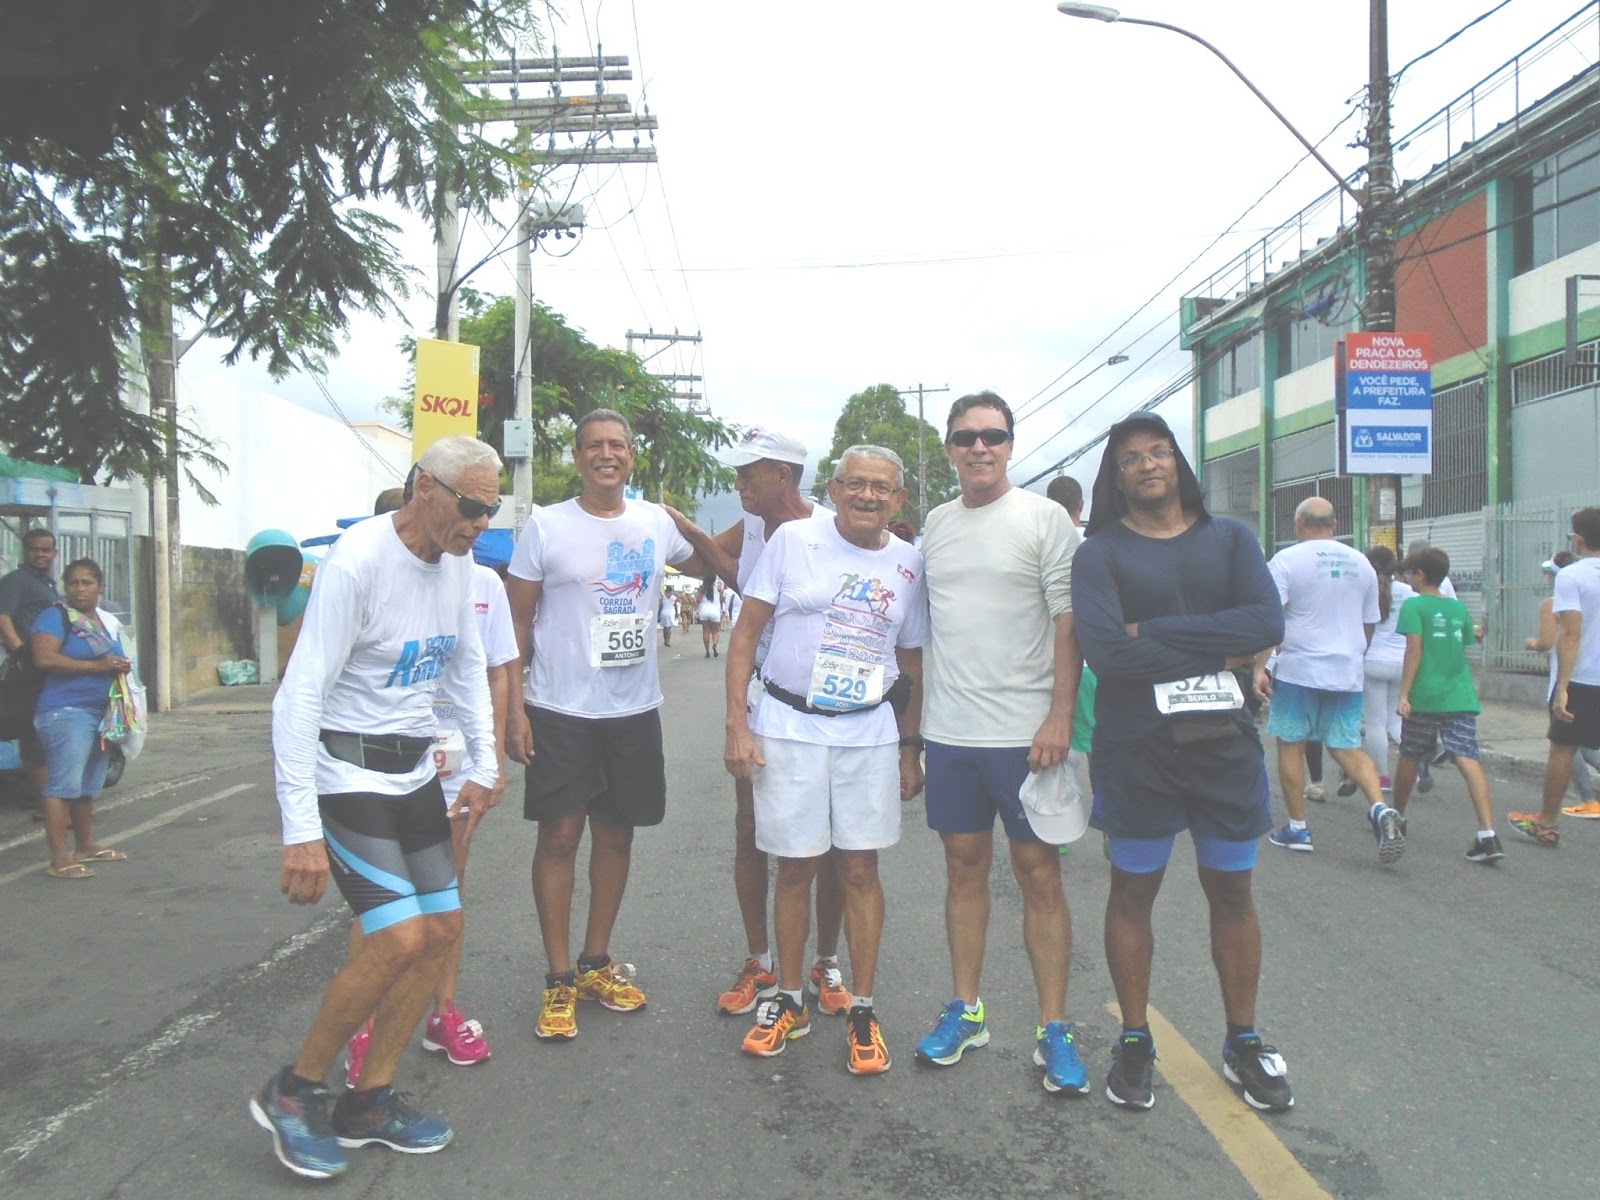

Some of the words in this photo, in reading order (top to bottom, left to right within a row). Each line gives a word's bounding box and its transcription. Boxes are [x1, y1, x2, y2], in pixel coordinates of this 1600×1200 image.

[1372, 336, 1405, 347] NOVA
[1356, 348, 1395, 359] PRAÇA
[1397, 348, 1422, 358] DOS
[1350, 360, 1428, 370] DENDEZEIROS
[1360, 374, 1388, 386] VOCÊ
[1389, 376, 1420, 387] PEDE,
[1353, 386, 1361, 395] A
[1363, 386, 1426, 396] PREFEITURA
[420, 393, 473, 418] SKOL
[1378, 396, 1401, 406] FAZ.
[1376, 432, 1422, 442] SALVADOR
[600, 597, 632, 607] CORRIDA
[603, 607, 636, 615] SAGRADA
[608, 629, 644, 651] 565
[615, 651, 639, 659] ANTONIO
[822, 673, 867, 701] 529
[1187, 694, 1217, 702] BERILO
